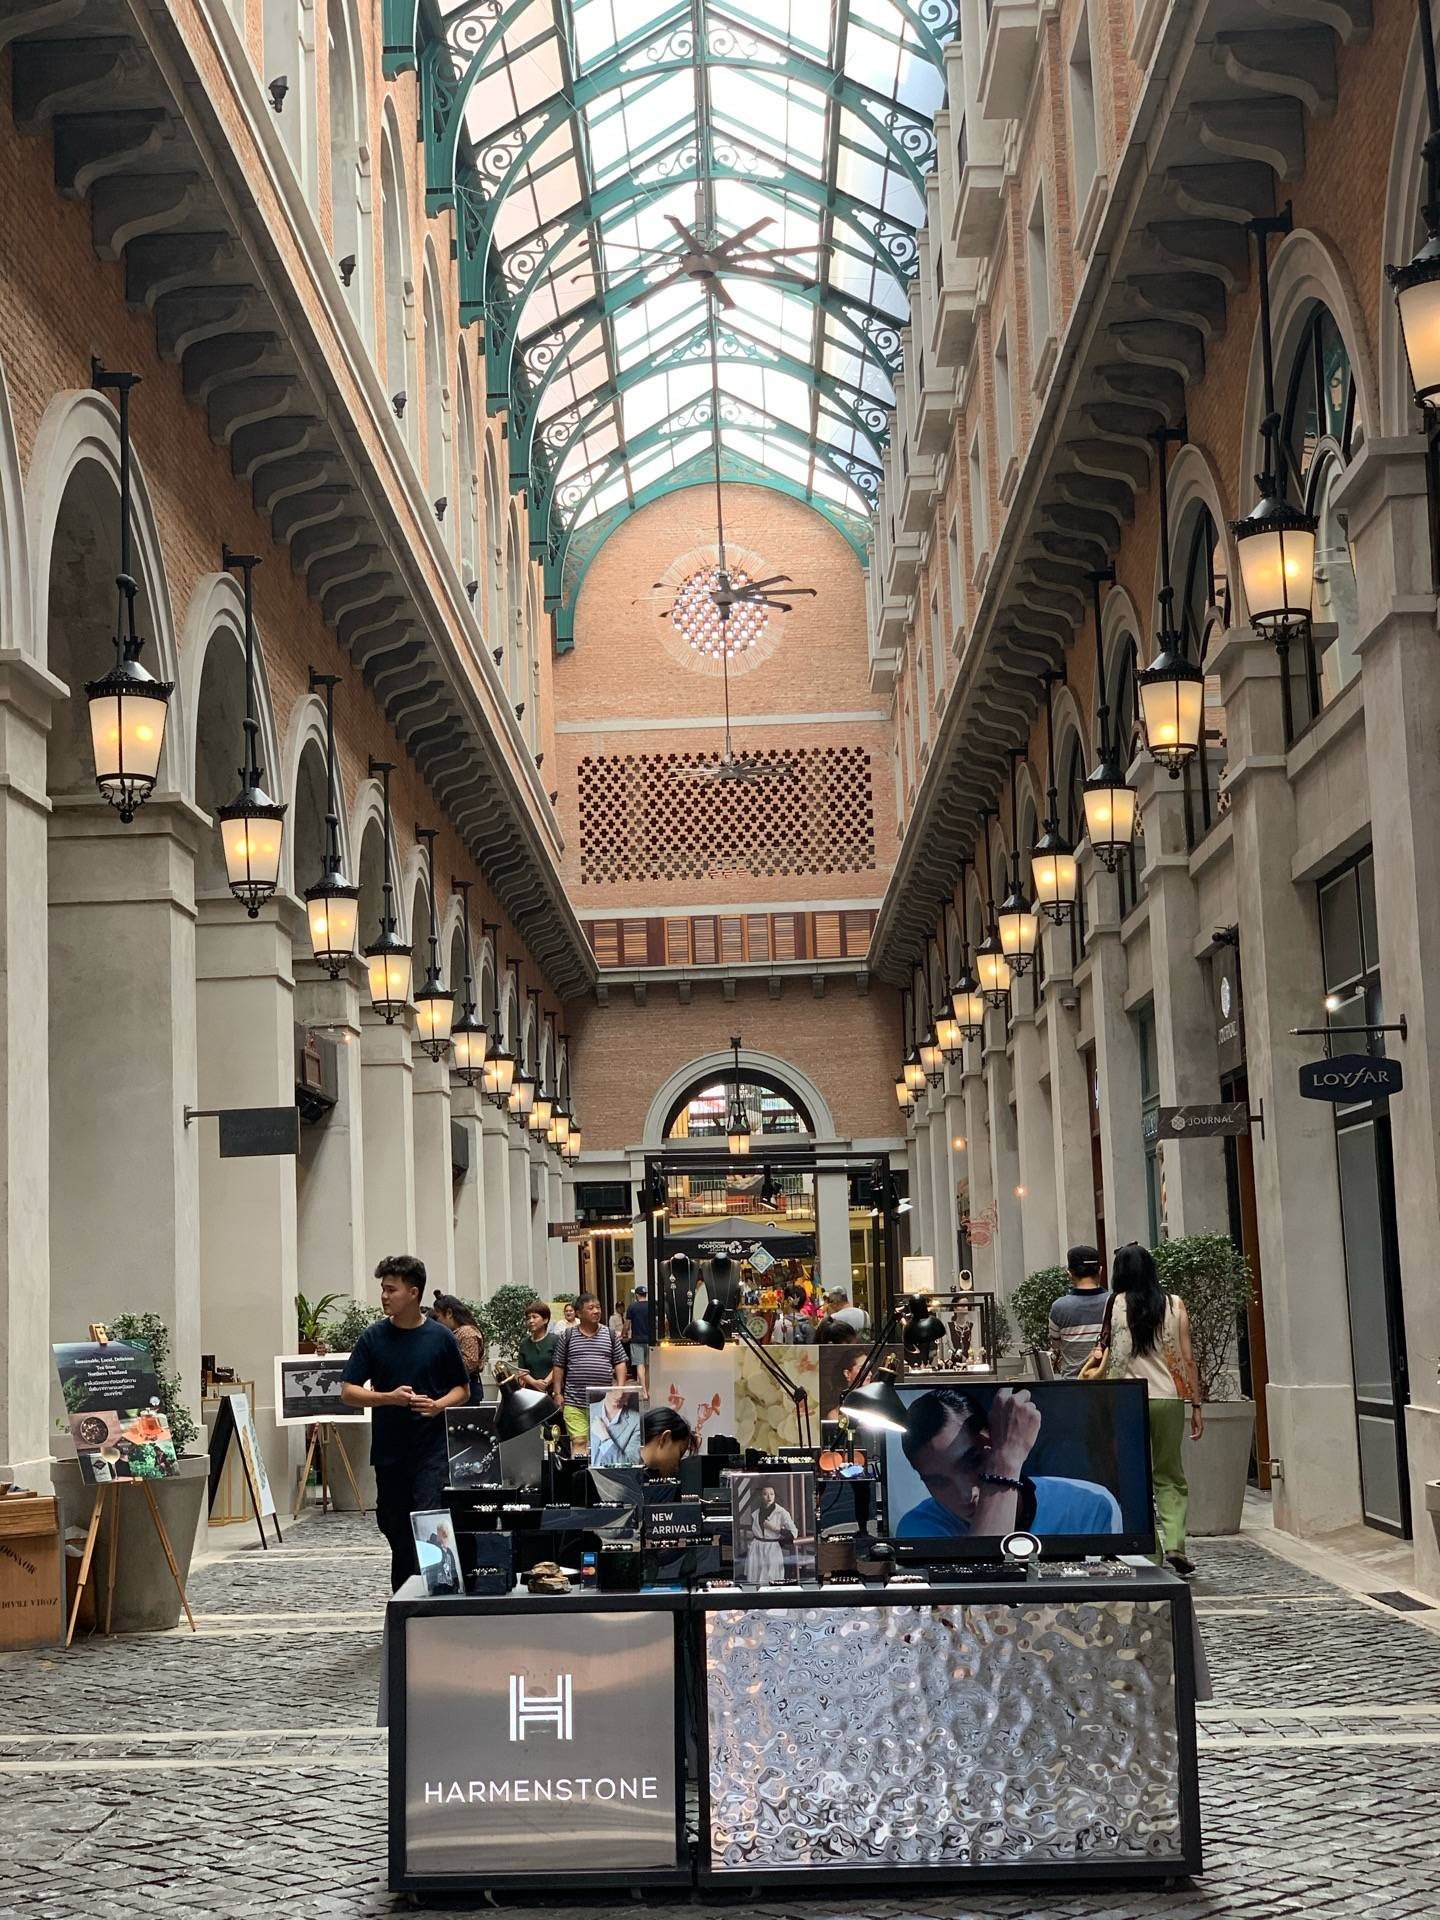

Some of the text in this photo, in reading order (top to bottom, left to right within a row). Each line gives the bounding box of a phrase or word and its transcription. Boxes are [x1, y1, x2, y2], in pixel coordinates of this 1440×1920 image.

[1188, 1116, 1234, 1127] JOURNAL
[651, 1512, 674, 1522] NEW
[652, 1524, 697, 1535] ARRIVALS
[425, 1777, 658, 1803] HARMENSTONE
